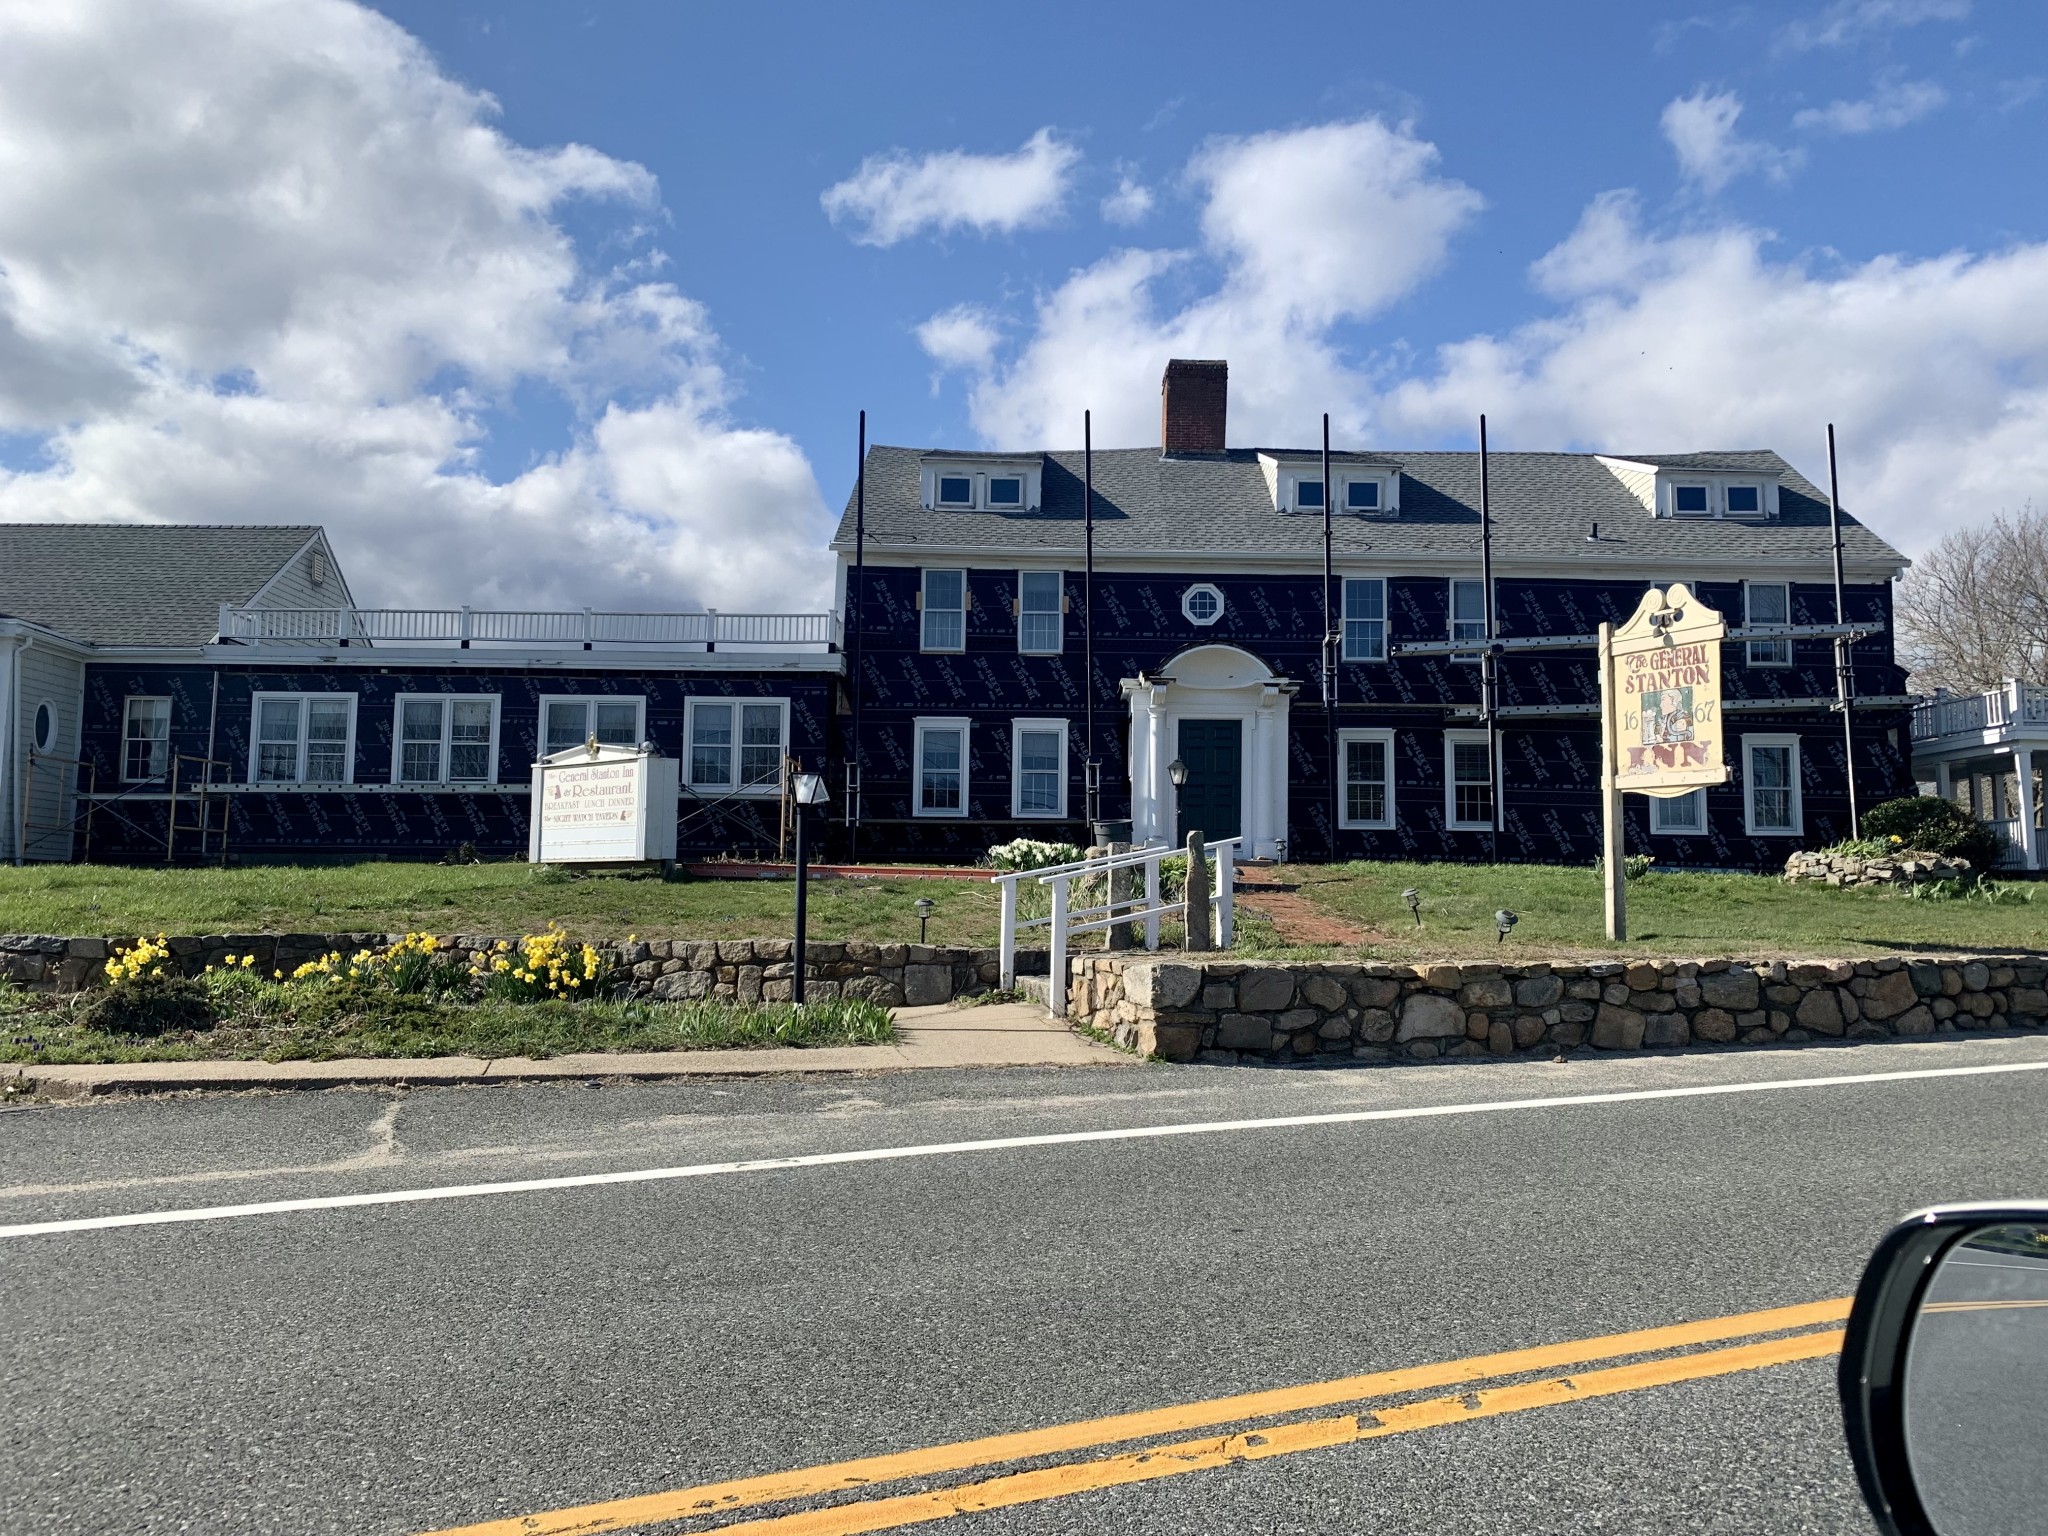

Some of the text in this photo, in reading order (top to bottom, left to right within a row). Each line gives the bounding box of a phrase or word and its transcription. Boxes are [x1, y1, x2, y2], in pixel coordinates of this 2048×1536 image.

[1625, 643, 1710, 674] The GENERAL
[1625, 663, 1710, 694] STANTON
[1627, 740, 1712, 769] INN
[559, 769, 589, 783] General
[591, 768, 620, 781] Stanton
[623, 766, 634, 778] Inn
[564, 782, 633, 798] & Restaurant
[545, 797, 635, 811] BREAKFAST LUNCH DINNER
[553, 814, 571, 823] NIGHT
[573, 813, 594, 822] WATCH
[595, 811, 618, 822] TAVERN
